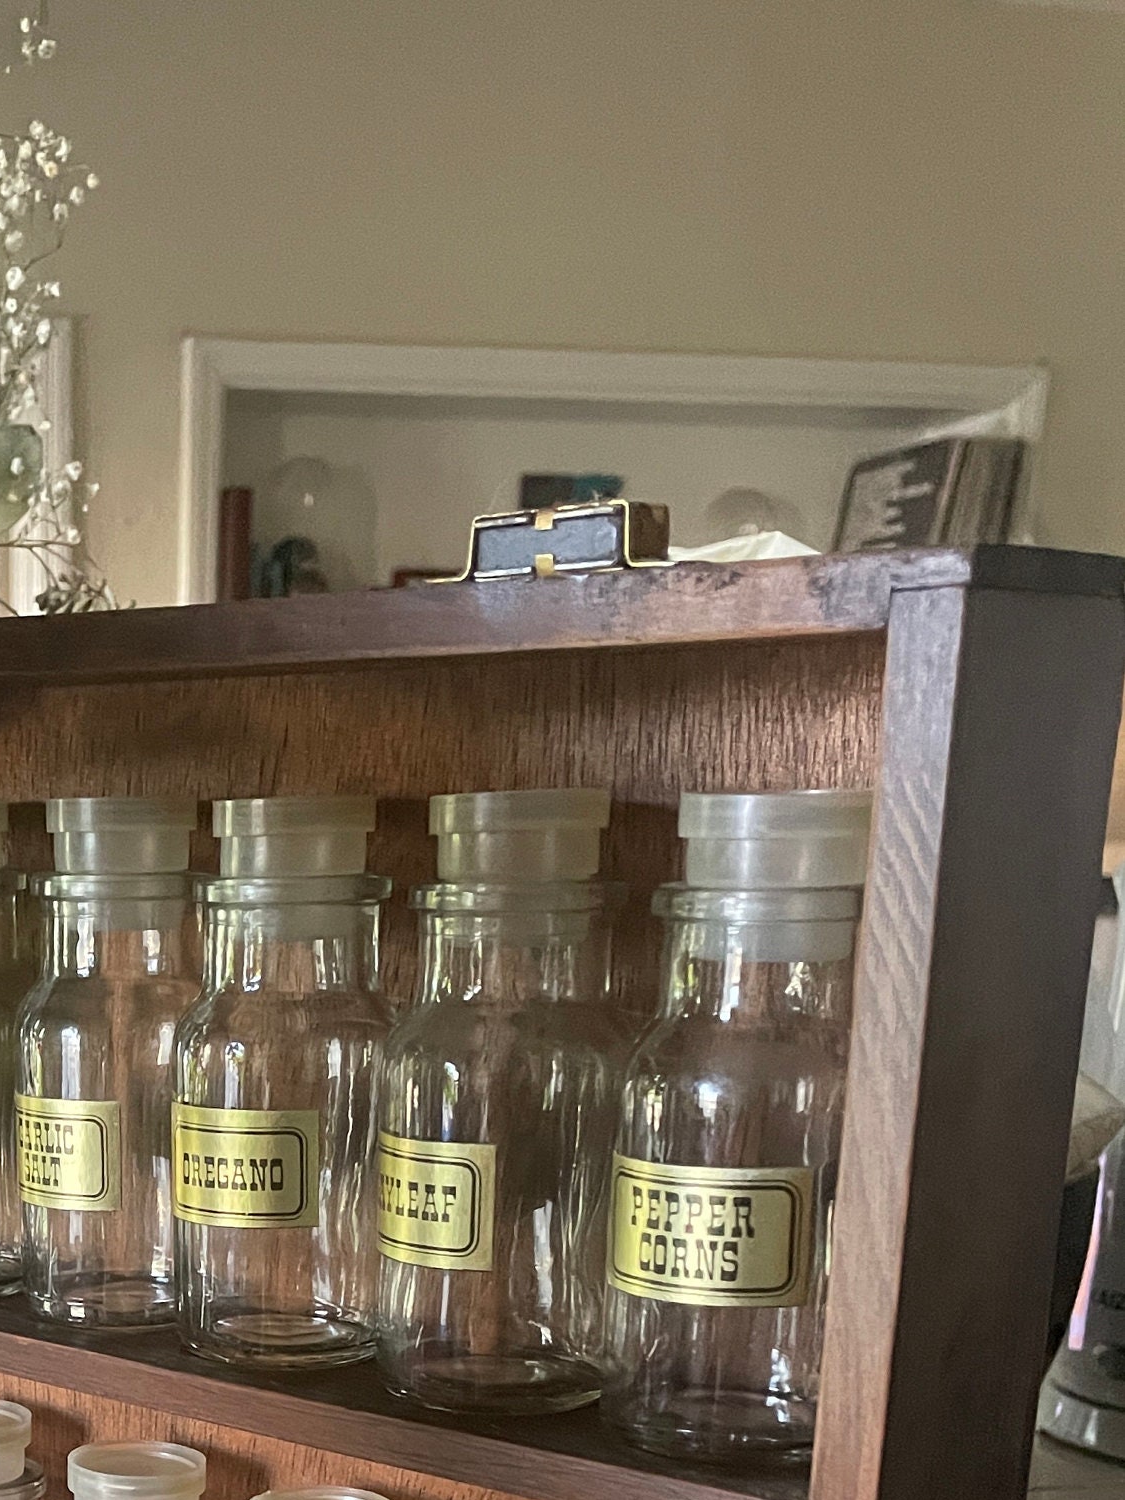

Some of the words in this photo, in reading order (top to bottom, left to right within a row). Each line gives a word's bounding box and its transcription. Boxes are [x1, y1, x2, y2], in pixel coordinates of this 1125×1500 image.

[25, 1152, 61, 1187] SALT
[182, 1152, 284, 1191] OREGANO
[631, 1184, 755, 1239] PEPPER
[640, 1232, 739, 1282] CORNS
